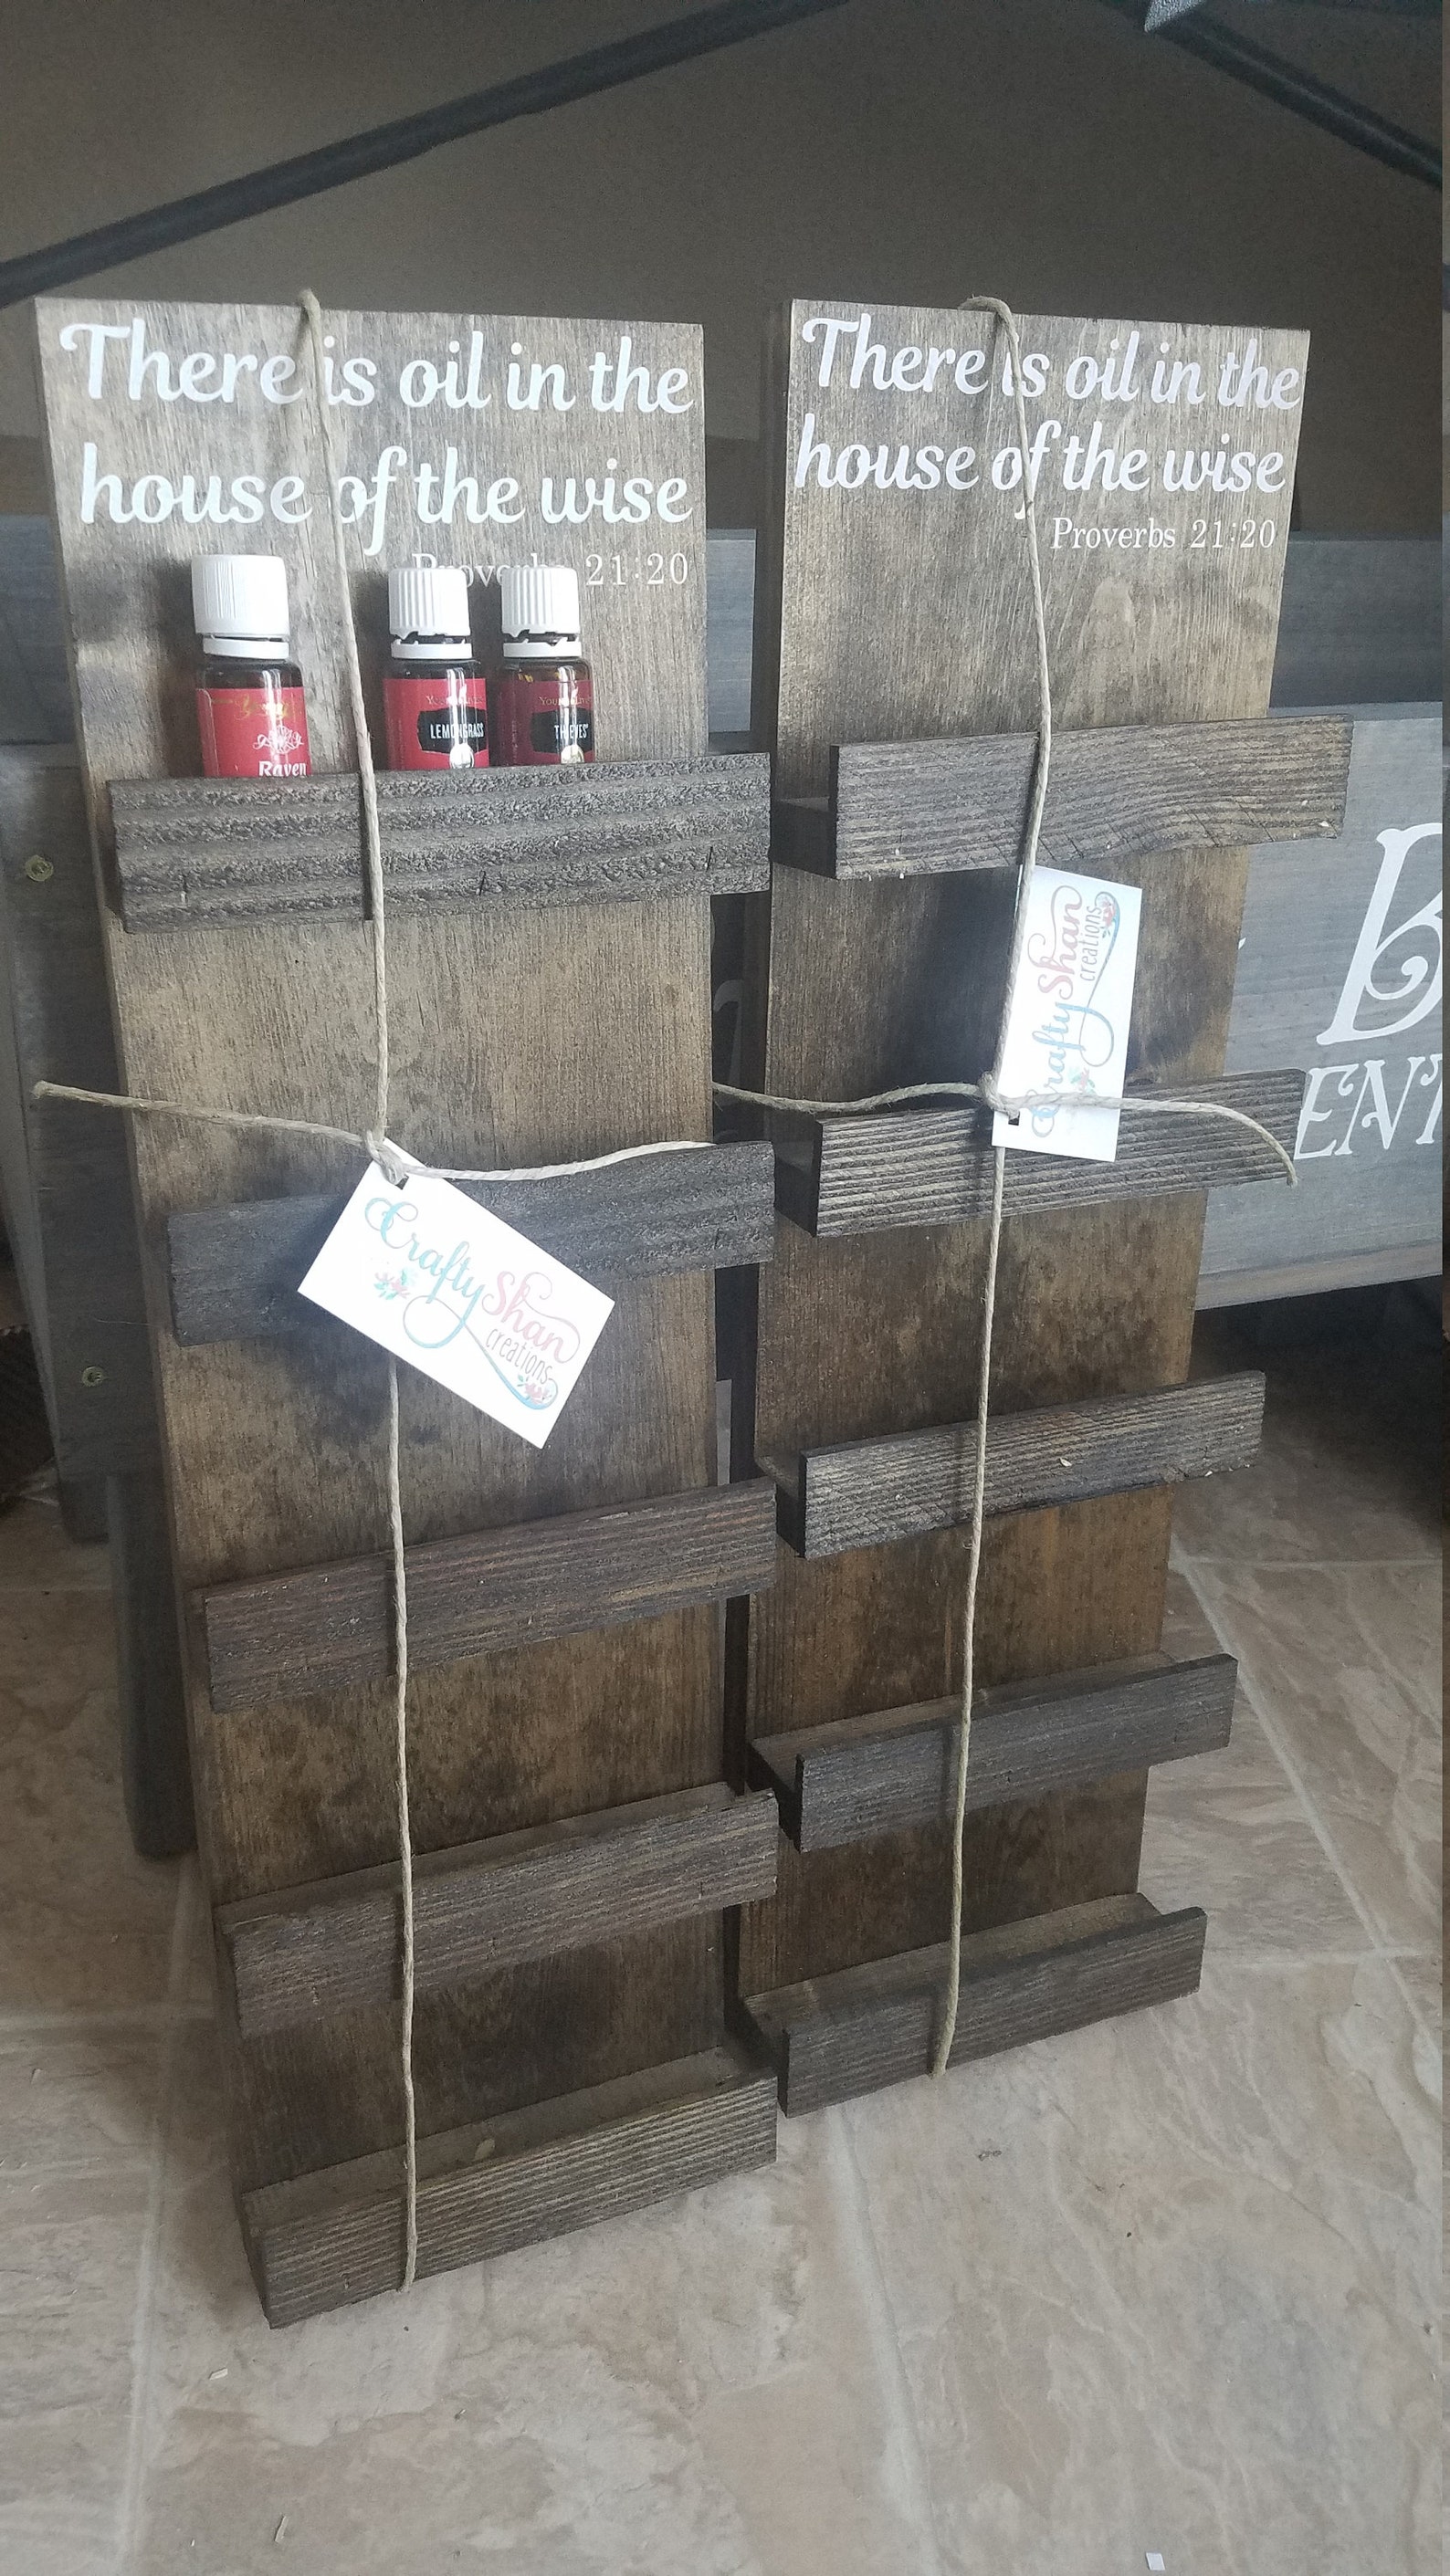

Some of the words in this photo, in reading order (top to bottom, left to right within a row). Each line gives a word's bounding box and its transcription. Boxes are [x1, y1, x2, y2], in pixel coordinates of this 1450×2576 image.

[59, 318, 304, 406] There
[323, 335, 377, 407] is
[400, 330, 489, 408] oil
[505, 342, 575, 411] in
[589, 336, 694, 414] the
[803, 313, 988, 395] There
[1002, 332, 1049, 398] is
[1066, 330, 1139, 402] oil
[1151, 341, 1206, 405] in
[1218, 339, 1301, 409] the
[80, 443, 313, 526] house
[338, 445, 407, 557] of
[414, 447, 526, 526] the
[540, 458, 693, 524] wise
[794, 414, 980, 490] house
[992, 420, 1061, 519] of
[1061, 422, 1151, 491] the
[1162, 433, 1286, 493] wise
[585, 553, 688, 586] 21:20
[1050, 517, 1176, 549] Proverbs
[1191, 518, 1276, 549] 21:20
[258, 760, 308, 777] Raven
[430, 722, 484, 739] LEMONGRASS
[1027, 885, 1082, 1000] Shan
[1080, 906, 1103, 982] creations
[364, 1197, 486, 1349] Crafty
[482, 1271, 581, 1364] Shan
[485, 1328, 555, 1386] creations
